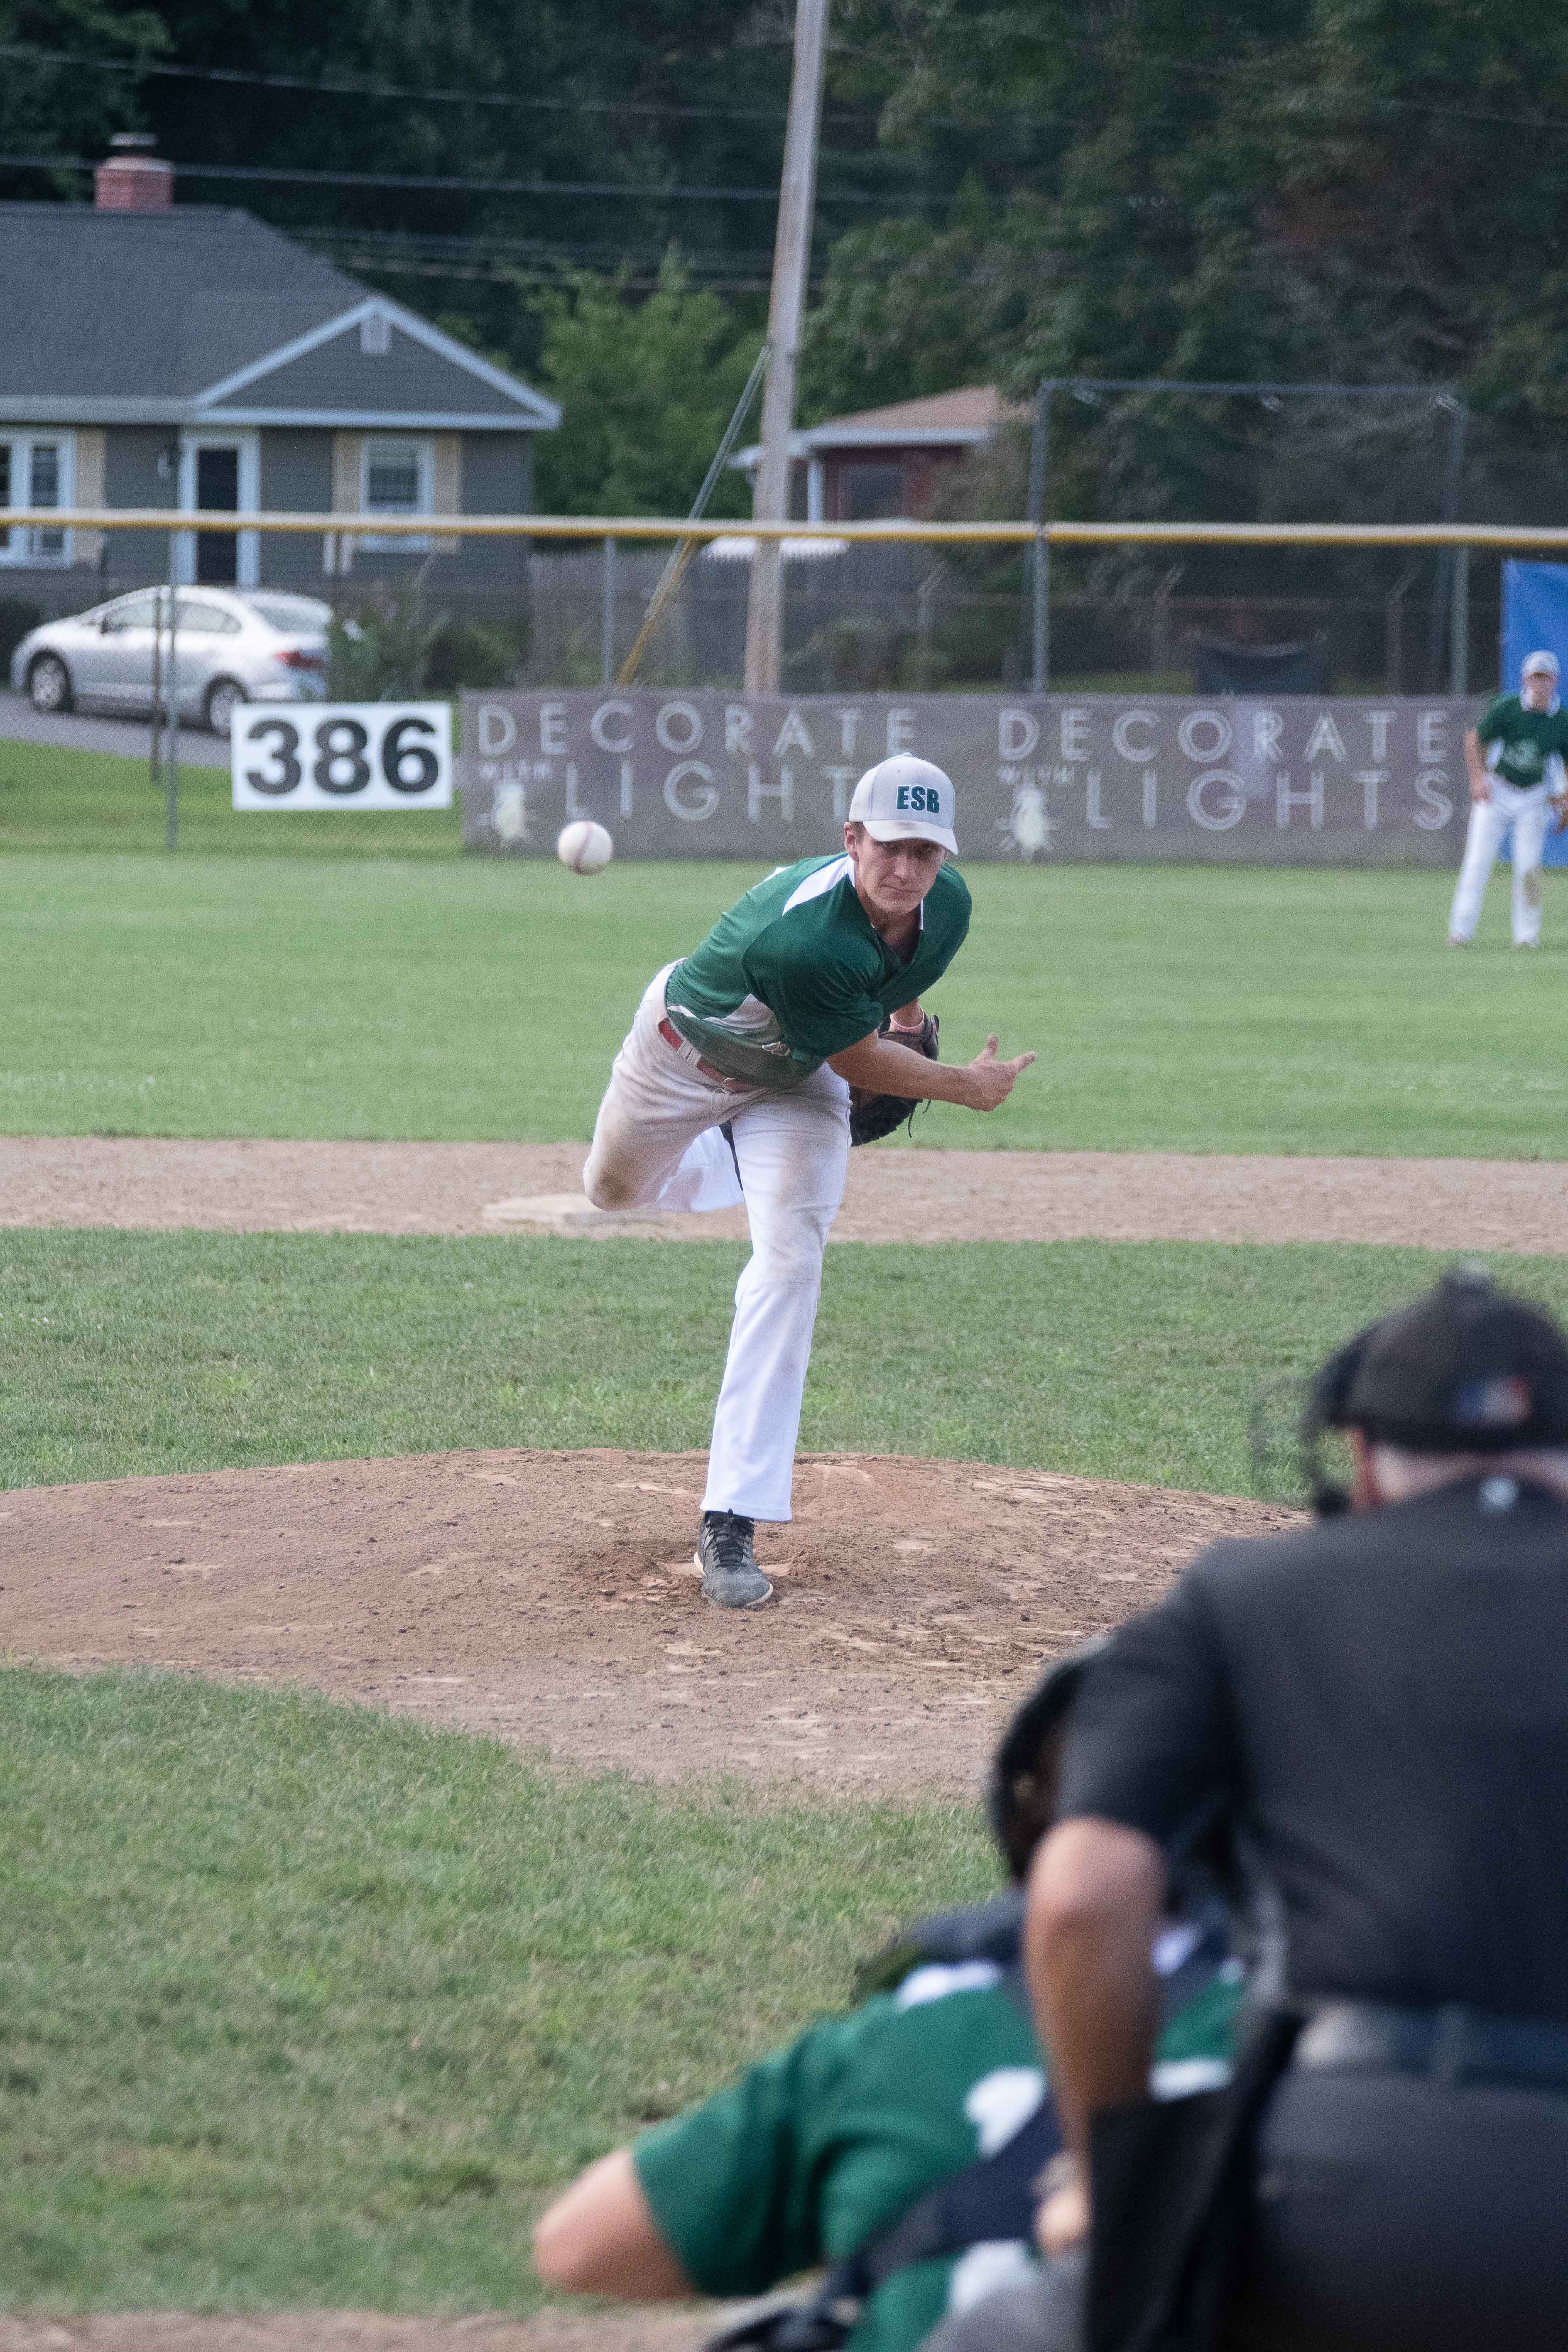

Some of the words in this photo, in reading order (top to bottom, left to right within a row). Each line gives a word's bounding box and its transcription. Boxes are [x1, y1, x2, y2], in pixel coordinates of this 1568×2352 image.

[247, 718, 439, 794] 386
[478, 700, 915, 759] DECORATE
[999, 708, 1448, 762] DECORATE
[566, 760, 858, 822] LIGHT
[896, 785, 940, 814] ESB
[1086, 769, 1453, 831] LIGHTS
